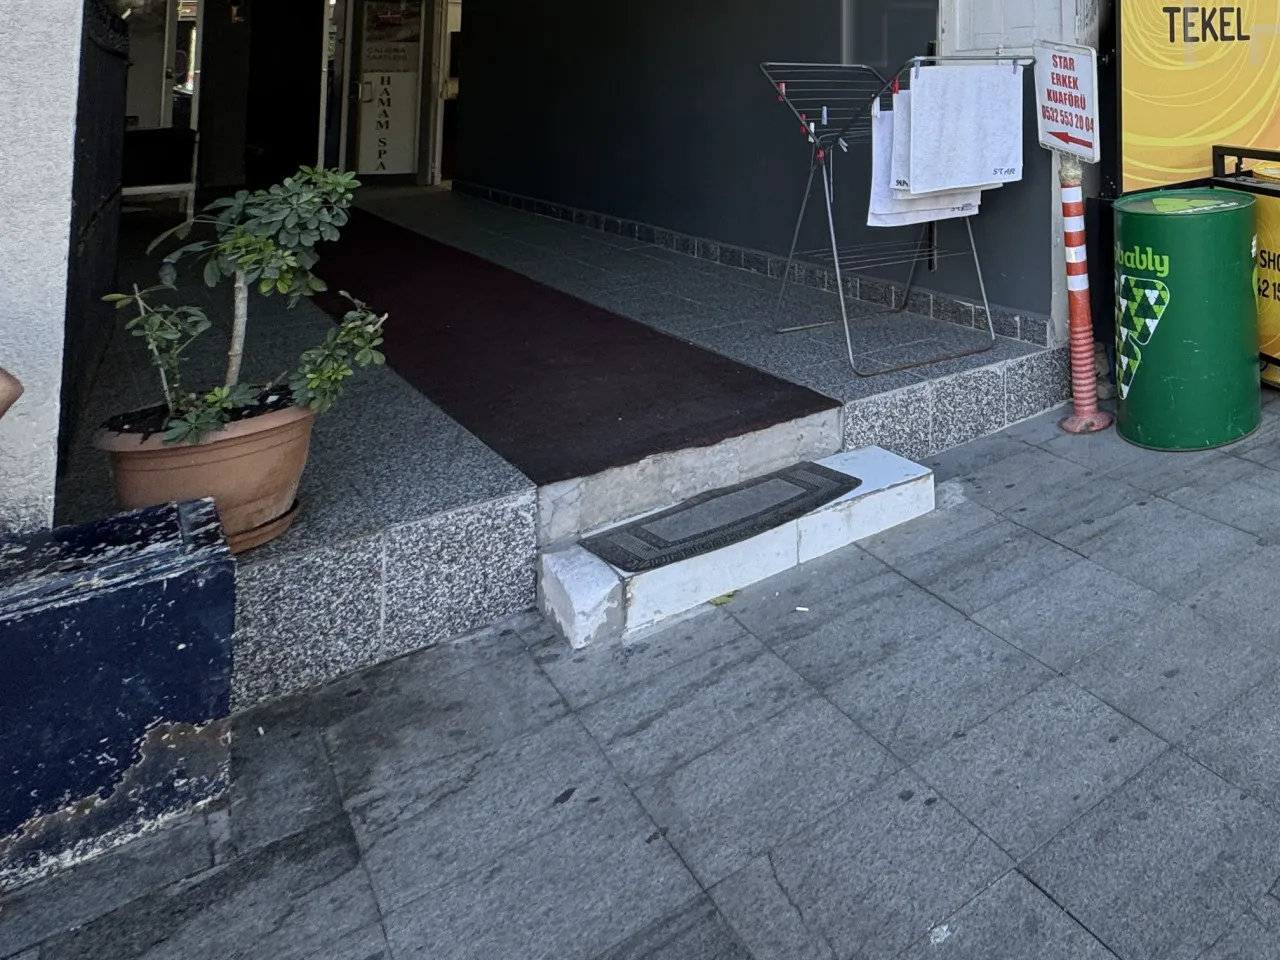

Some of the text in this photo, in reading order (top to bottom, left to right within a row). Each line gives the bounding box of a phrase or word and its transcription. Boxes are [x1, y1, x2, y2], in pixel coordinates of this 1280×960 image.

[1162, 7, 1250, 43] TEKEL
[1052, 54, 1075, 71] STAR
[1051, 72, 1079, 90] ERKEK
[1046, 88, 1086, 110] KUAFÖRÜ
[1041, 104, 1094, 134] 0532 553 20 04
[1116, 241, 1169, 278] bably
